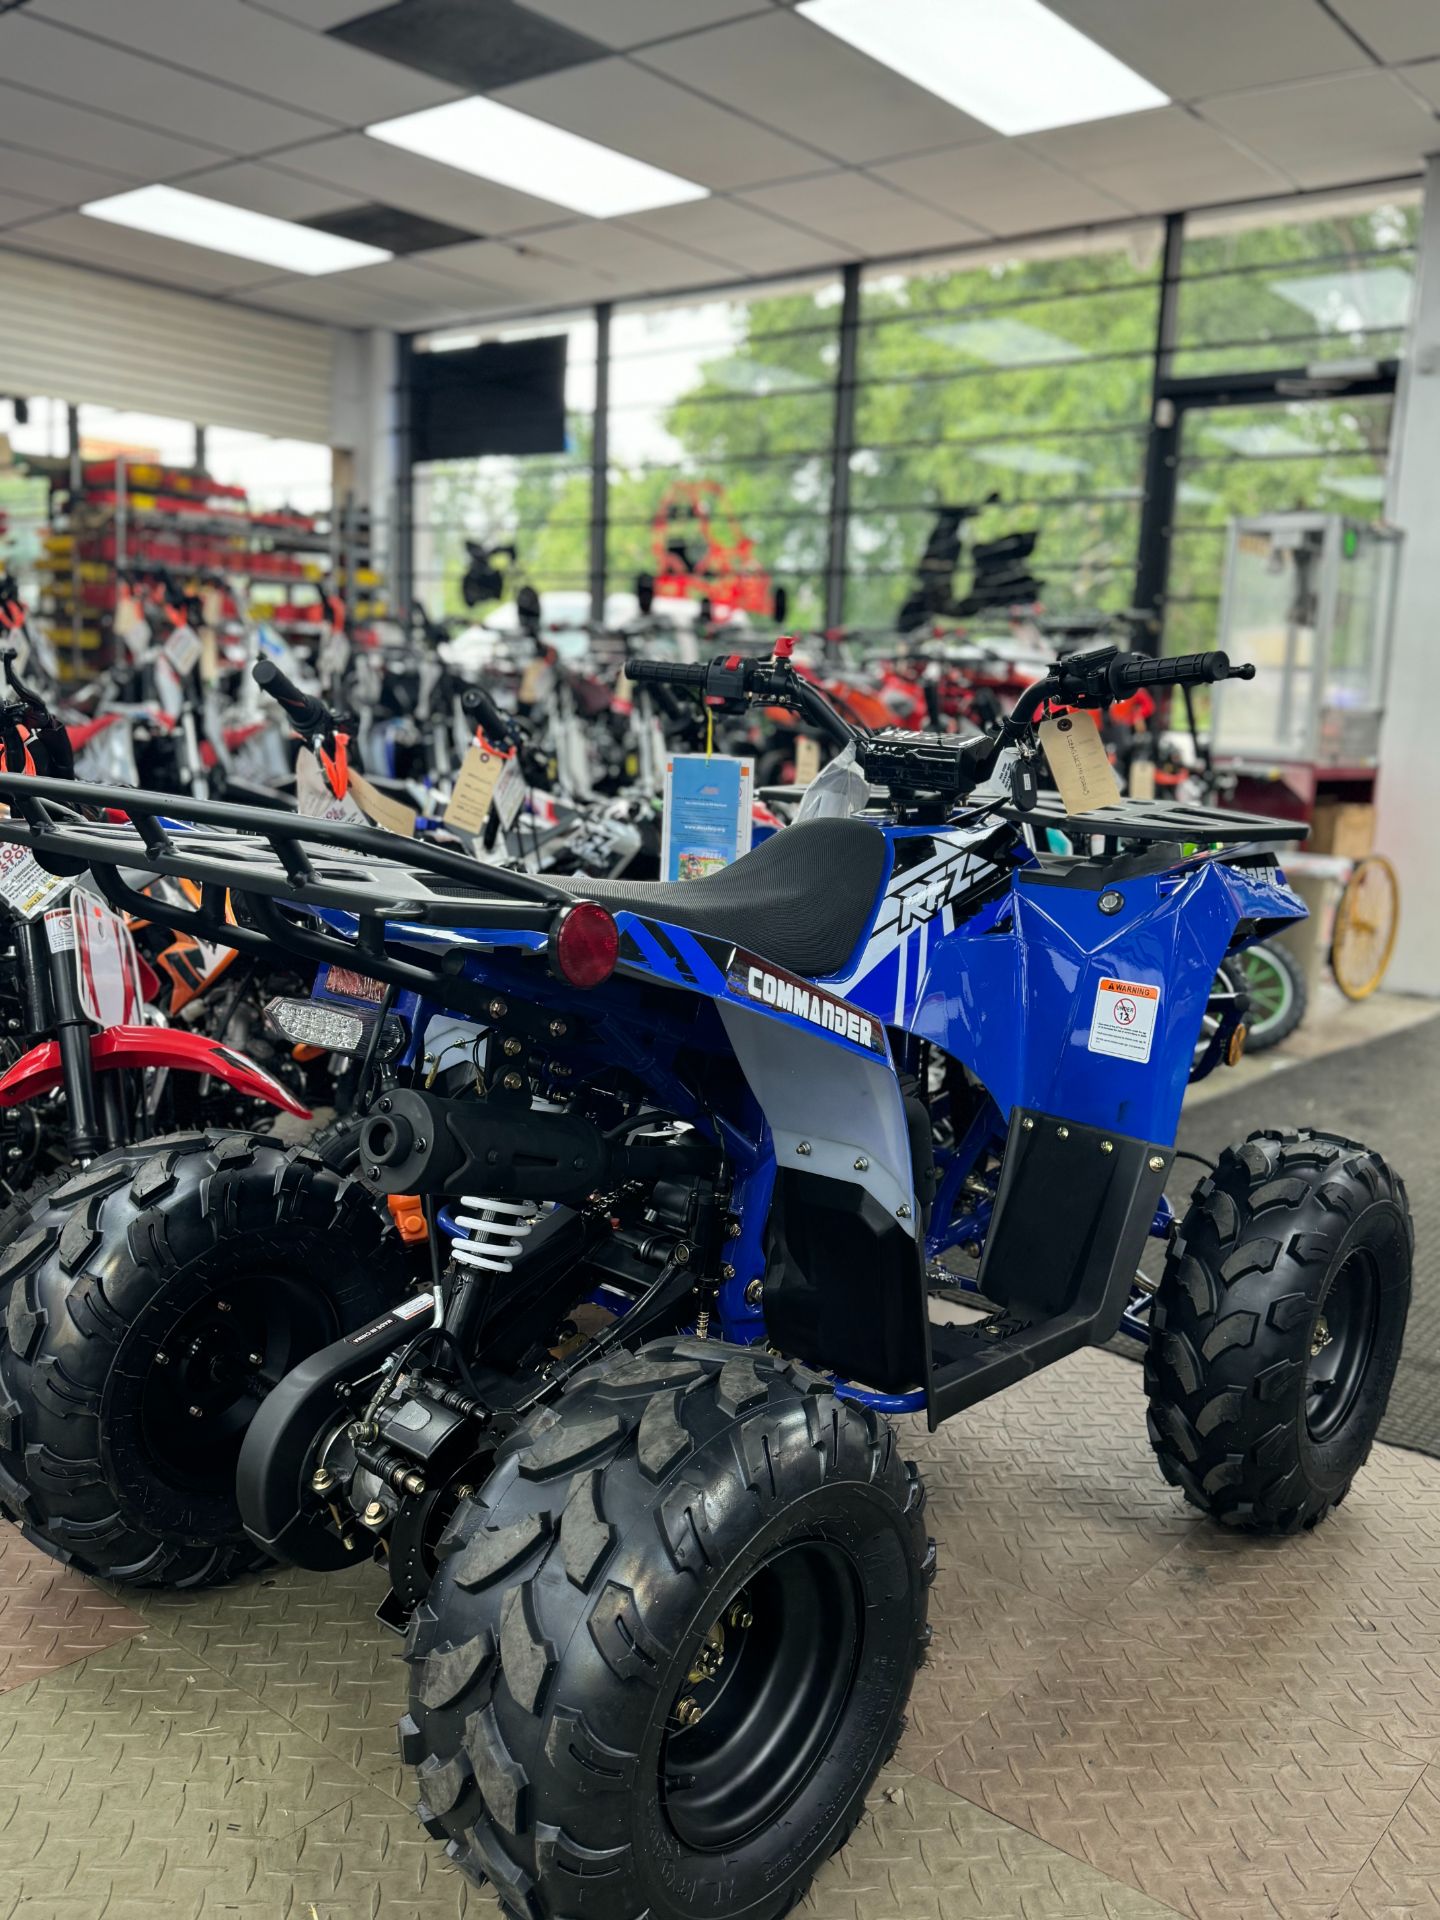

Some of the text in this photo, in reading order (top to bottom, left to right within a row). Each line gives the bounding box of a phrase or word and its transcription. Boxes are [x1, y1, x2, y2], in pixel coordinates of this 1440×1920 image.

[1116, 984, 1150, 996] WARNING
[747, 966, 872, 1047] COMMANDER
[1119, 1012, 1130, 1021] 12
